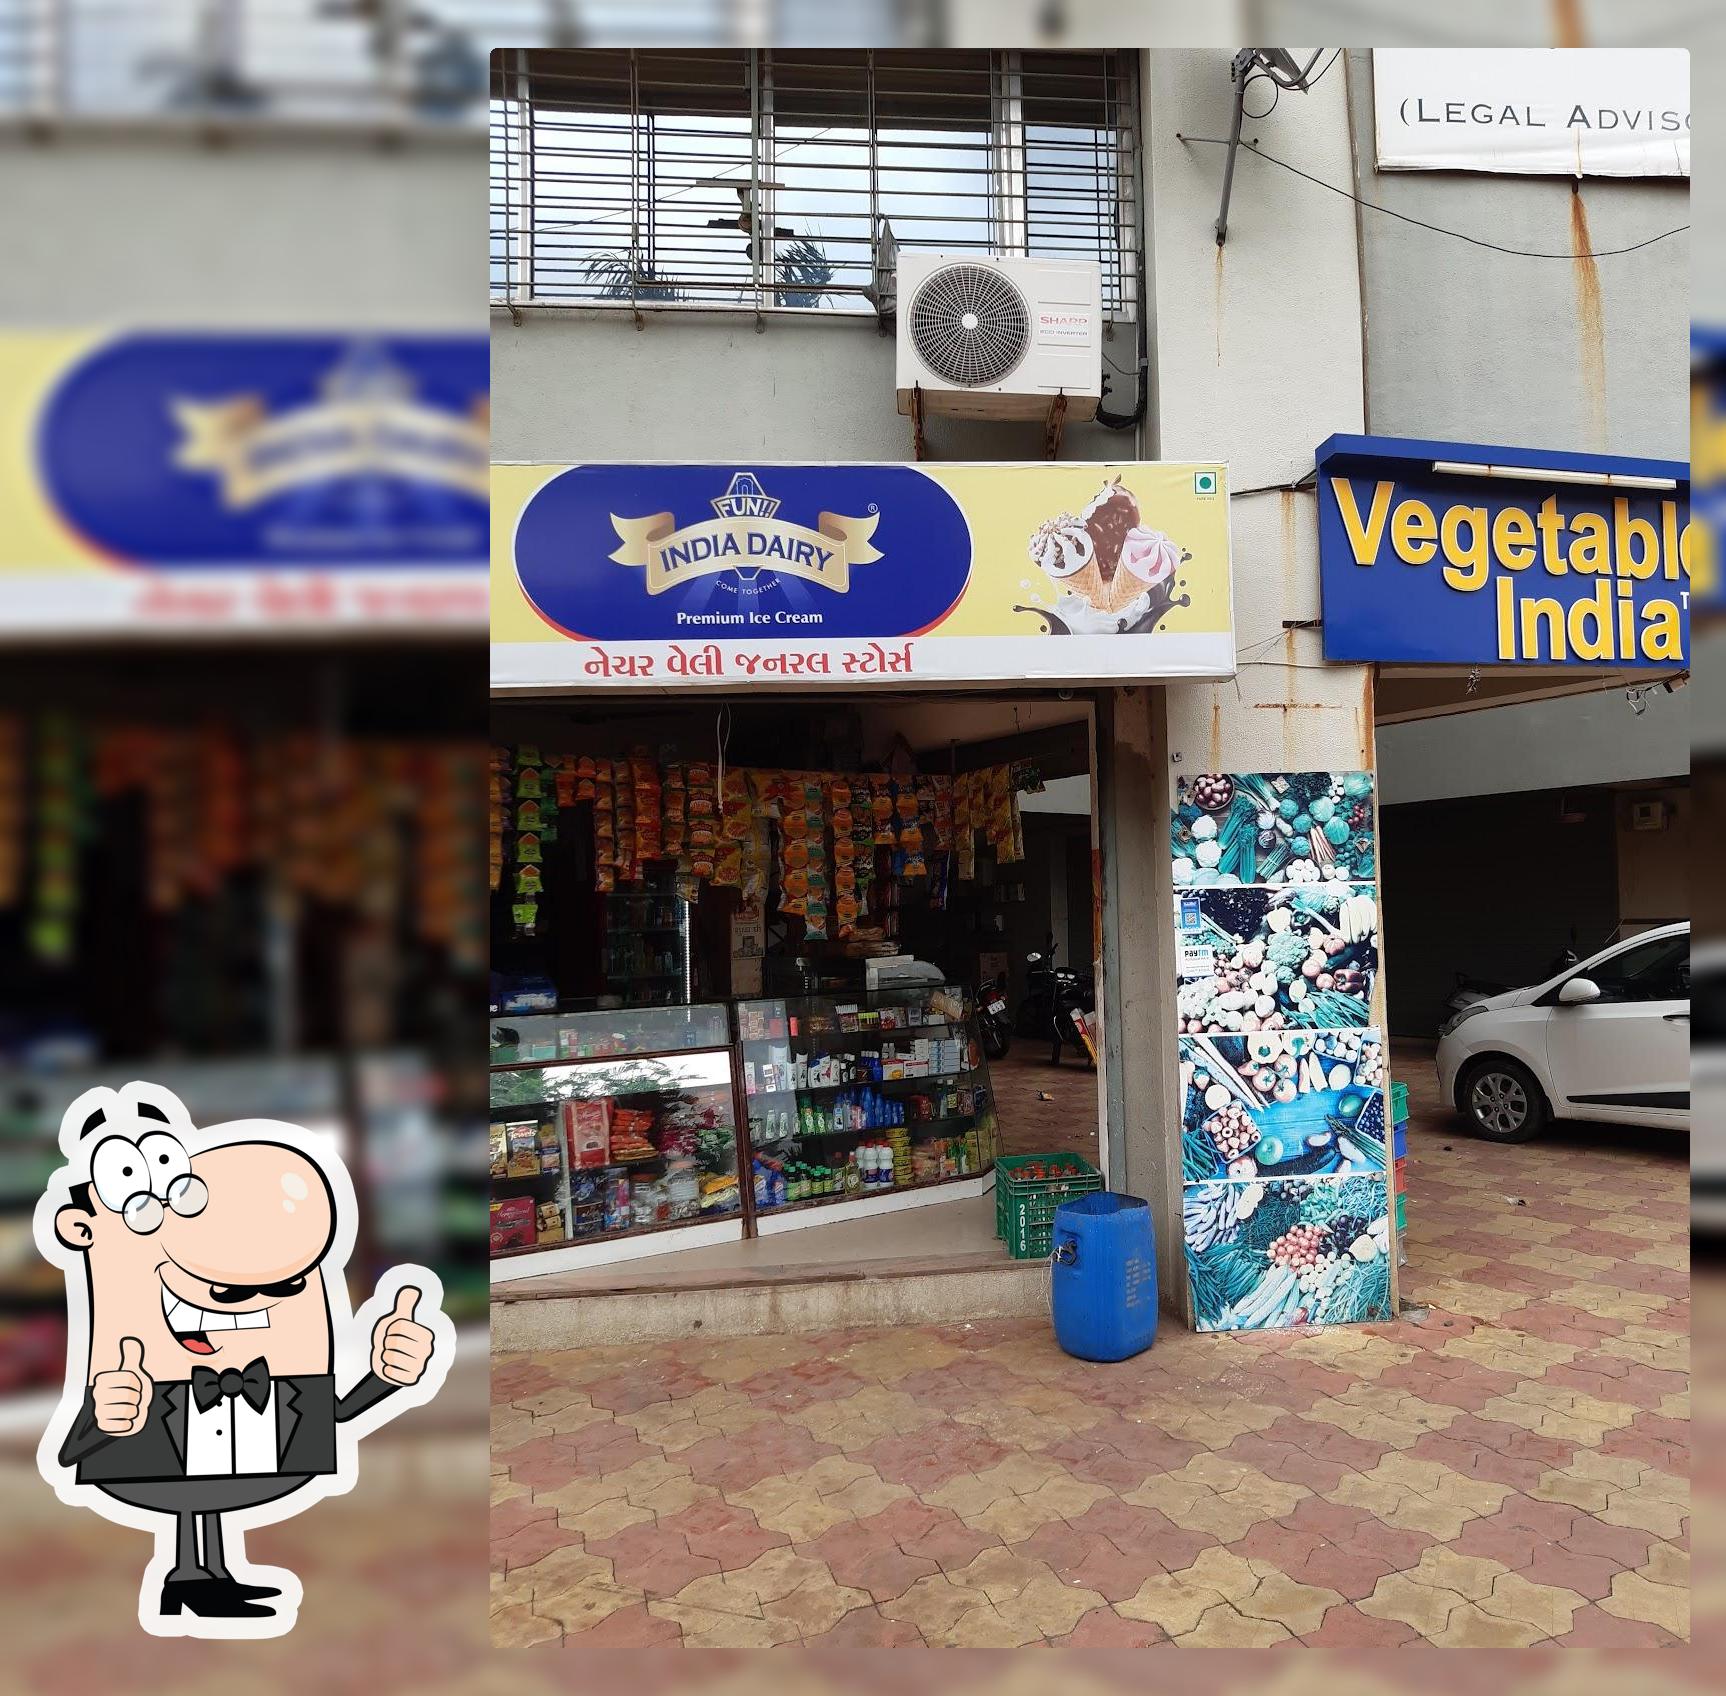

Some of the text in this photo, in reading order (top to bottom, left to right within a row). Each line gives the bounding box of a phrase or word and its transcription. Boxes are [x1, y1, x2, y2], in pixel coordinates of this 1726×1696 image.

[1039, 316, 1087, 325] SHARP
[721, 498, 776, 518] FUN!!
[660, 532, 834, 572] INDIA DAIRY
[1331, 477, 1690, 592] Vegetabl
[715, 577, 782, 595] COME TOGETHER
[677, 611, 823, 625] Premium Ice Cream
[1496, 576, 1683, 660] India
[584, 642, 914, 677] નેચર વેલી જનરલ સ્ટોર્સ
[1019, 1203, 1027, 1252] 2016
